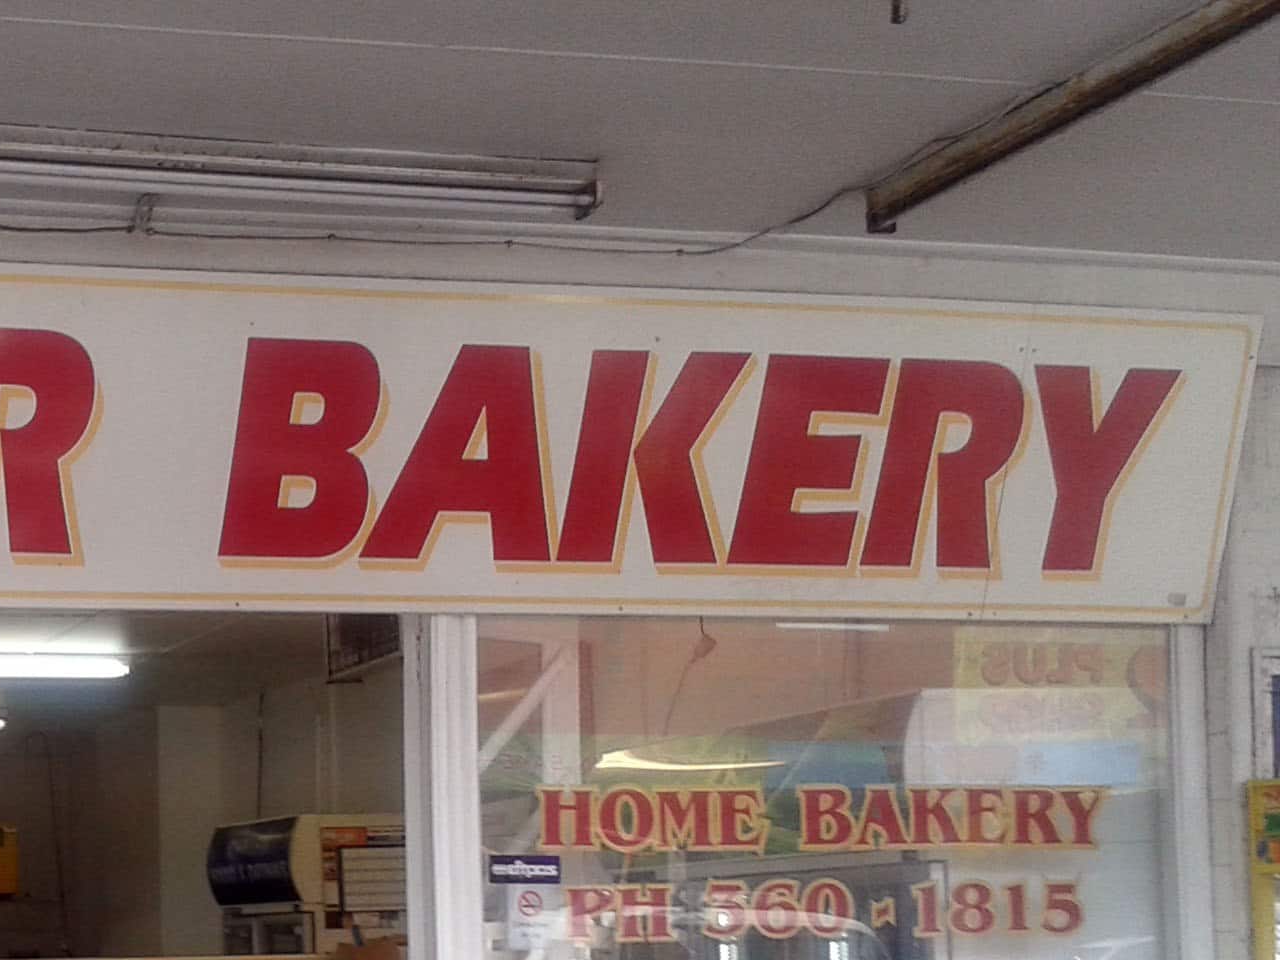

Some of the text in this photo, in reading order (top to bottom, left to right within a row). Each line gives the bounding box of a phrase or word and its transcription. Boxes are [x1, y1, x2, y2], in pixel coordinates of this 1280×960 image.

[217, 337, 1184, 582] BAKERY
[535, 784, 1112, 854] HOME BAKERY
[564, 884, 677, 943] PH
[701, 878, 856, 940] 560
[911, 880, 1086, 940] 1815
